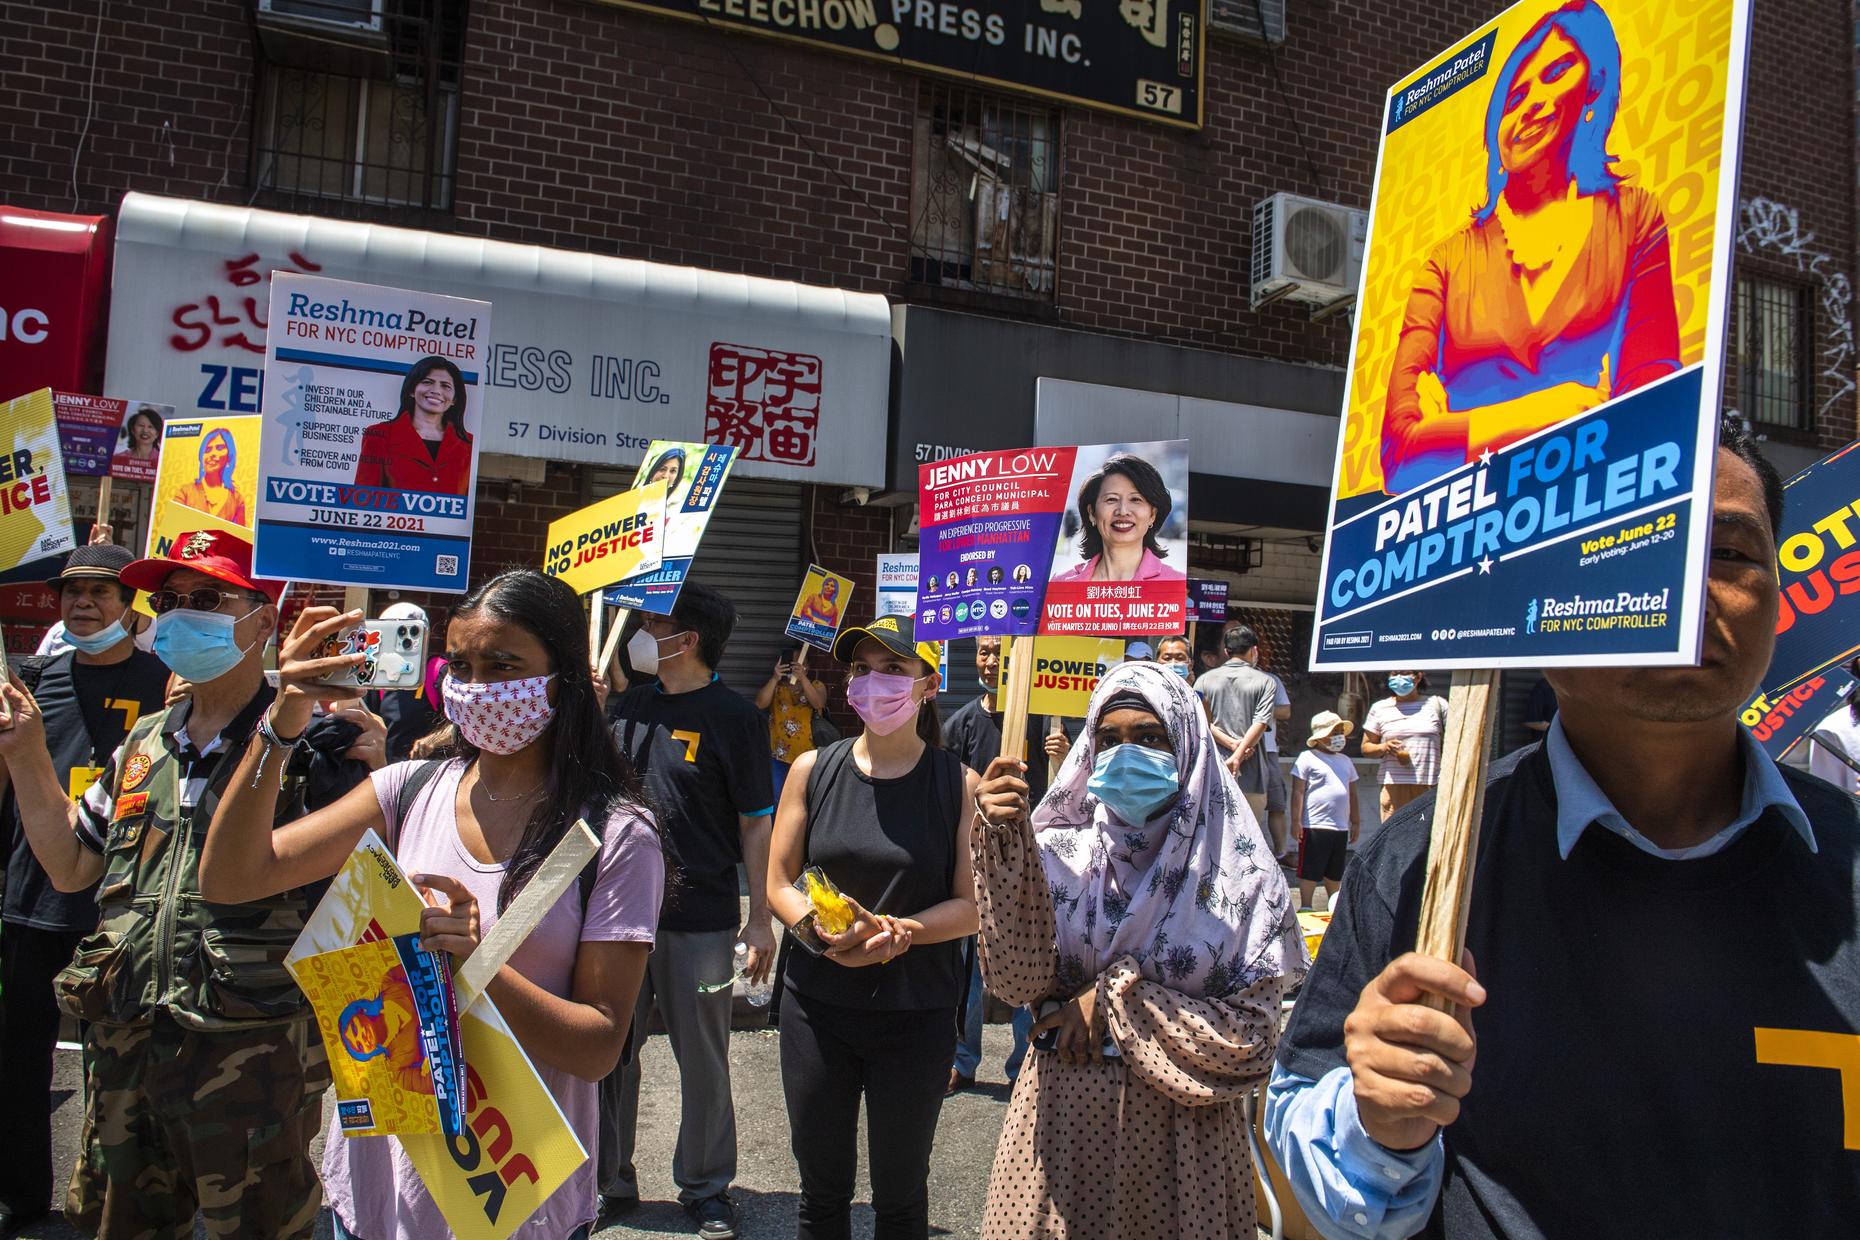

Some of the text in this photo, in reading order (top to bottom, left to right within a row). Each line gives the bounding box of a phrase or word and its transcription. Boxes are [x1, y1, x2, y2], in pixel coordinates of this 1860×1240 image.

[891, 0, 1005, 46] PRESS
[1025, 23, 1090, 66] INC.
[1144, 83, 1174, 108] 57
[1404, 60, 1484, 116] FOR NYC COMPTROLLER
[287, 320, 475, 360] FOR NYC COMPTROLLER
[591, 355, 670, 405] INC.
[305, 384, 364, 399] INVEST IN OUR
[54, 394, 120, 409] JENNY LOW
[304, 393, 372, 409] CHILDREN AND A
[304, 403, 392, 421] SUSTAINABLE FUTURE
[302, 421, 340, 433] SUPPORT
[342, 426, 359, 435] OUR
[508, 422, 529, 438] 57
[539, 424, 606, 446] Division
[302, 431, 354, 444] BUSINESSES
[300, 448, 339, 461] RECOVER
[341, 453, 357, 463] AND
[915, 443, 932, 461] 57
[300, 458, 350, 470] FROM COVID
[925, 453, 1057, 490] JENNY LOW
[934, 482, 1020, 501] FOR CITY COUNCIL
[1375, 419, 1609, 552] PATEL FOR
[271, 481, 464, 515] VOTE VOTE VOTE
[934, 489, 1050, 511] PARA CONCEJO MUNICIPAL
[309, 509, 425, 532] JUNE 22 2021
[939, 519, 1031, 540] AN EXPERIENCED PROGRESSIVE
[1331, 441, 1682, 608] COMPTROLLER
[977, 531, 1031, 545] MANHATTAN
[1581, 513, 1676, 555] Vote June 22
[311, 536, 420, 552] www.Reshma2021.com
[547, 526, 654, 577] NO JUSTICE
[548, 540, 573, 562] NO
[1579, 529, 1675, 566] Early Voting: June 12-20
[960, 550, 996, 562] ENDORSED BY
[882, 562, 919, 573] Reshma
[882, 573, 893, 582] FOR
[894, 573, 905, 582] NYC
[923, 616, 935, 624] UFT
[1047, 605, 1073, 618] VOTE
[1076, 604, 1091, 618] ON
[1095, 604, 1123, 620] TUES,
[1126, 603, 1155, 618] JUNE
[798, 620, 816, 628] PATEL
[1062, 622, 1084, 631] MARTES
[1085, 622, 1092, 631] 22
[1093, 622, 1100, 631] DE
[1101, 622, 1118, 631] JUNIO
[1540, 613, 1667, 633] FOR NYC COMPTROLLER
[1457, 627, 1516, 640] @RESHMAPATELNYC
[1036, 659, 1107, 677] POWER
[410, 968, 448, 1100] PATEL FOR
